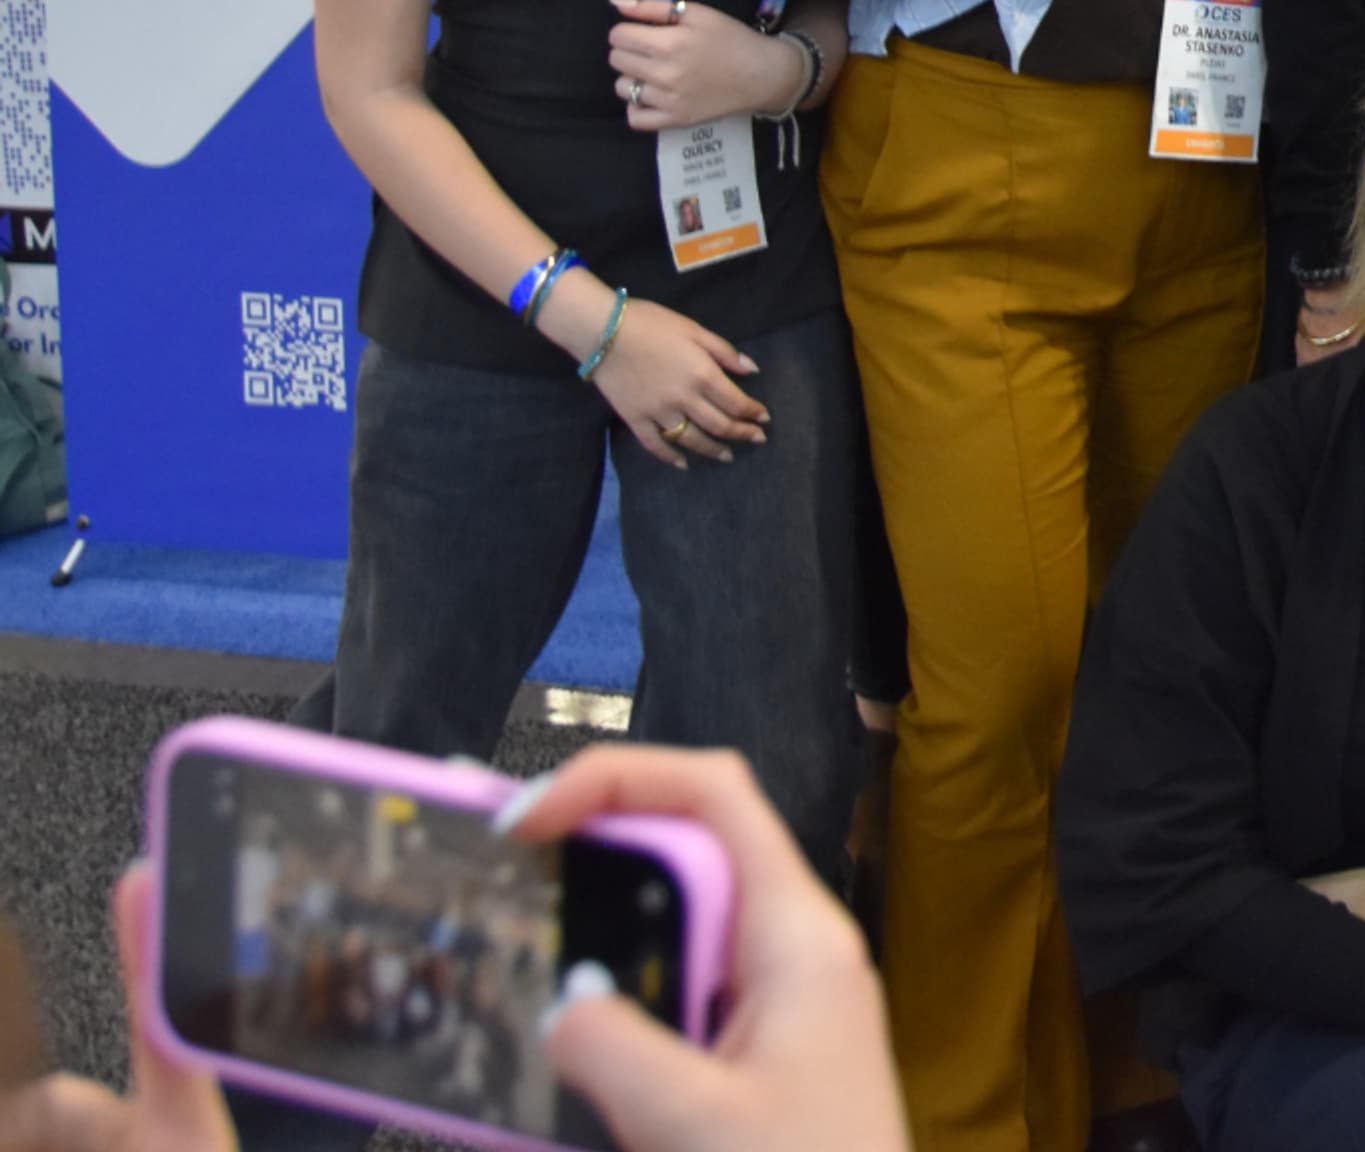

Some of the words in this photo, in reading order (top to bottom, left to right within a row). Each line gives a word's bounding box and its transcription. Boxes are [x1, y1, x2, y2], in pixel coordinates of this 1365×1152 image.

[1211, 7, 1242, 24] CES
[1172, 24, 1191, 39] DR.
[1195, 28, 1260, 45] ANASTASIA
[1185, 41, 1245, 58] STASENKO
[691, 128, 714, 144] LOU
